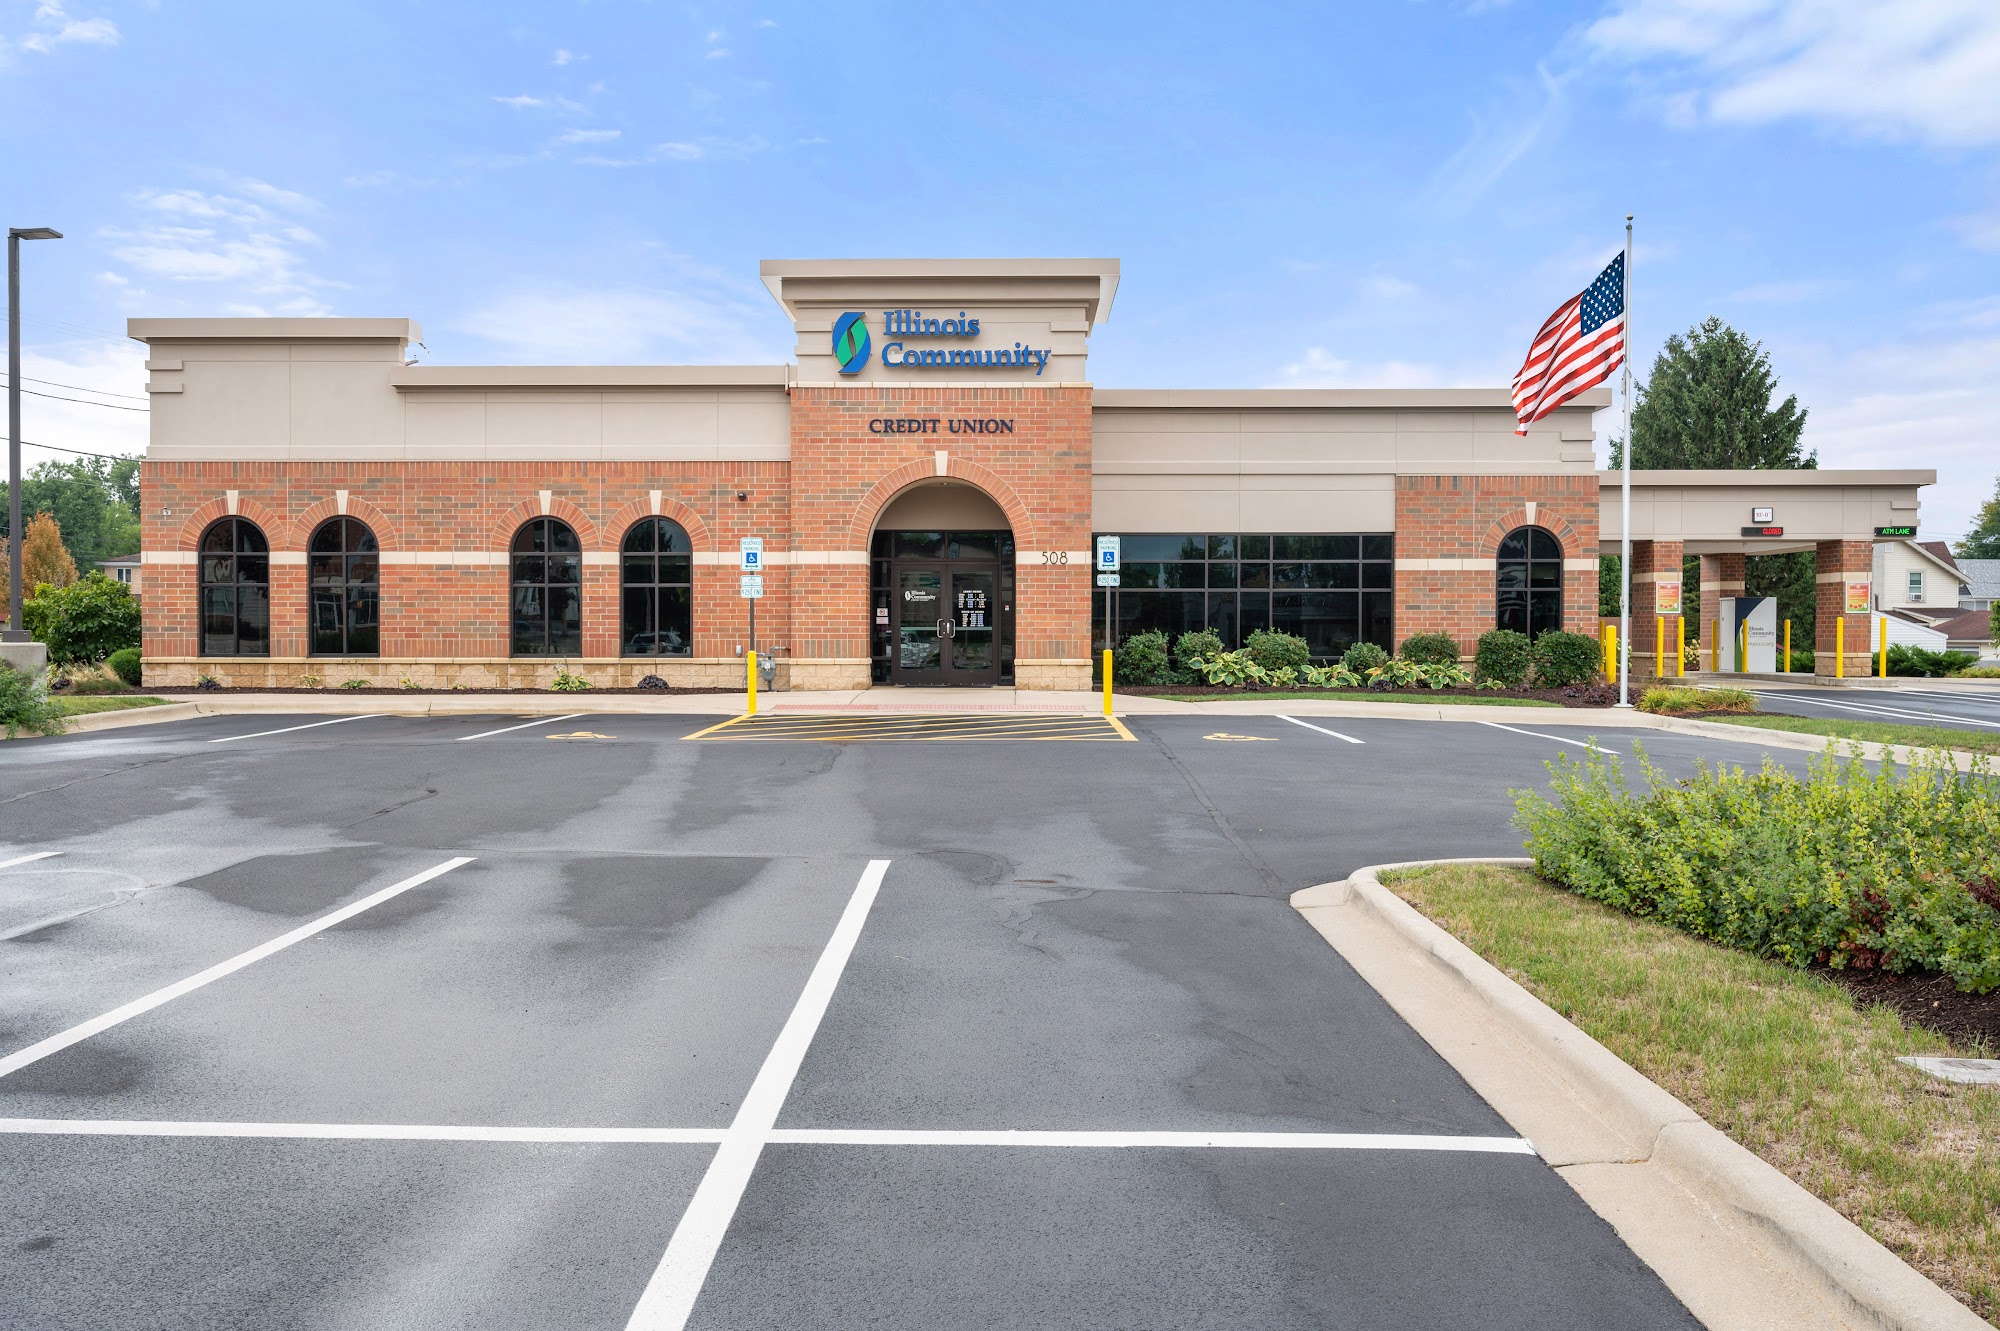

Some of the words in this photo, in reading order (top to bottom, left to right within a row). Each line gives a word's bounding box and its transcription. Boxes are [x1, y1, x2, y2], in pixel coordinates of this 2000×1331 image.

[883, 310, 981, 337] Illinois
[881, 342, 1051, 375] Community
[869, 419, 940, 433] CREDIT
[948, 419, 1014, 433] UNION
[1042, 551, 1068, 564] 508
